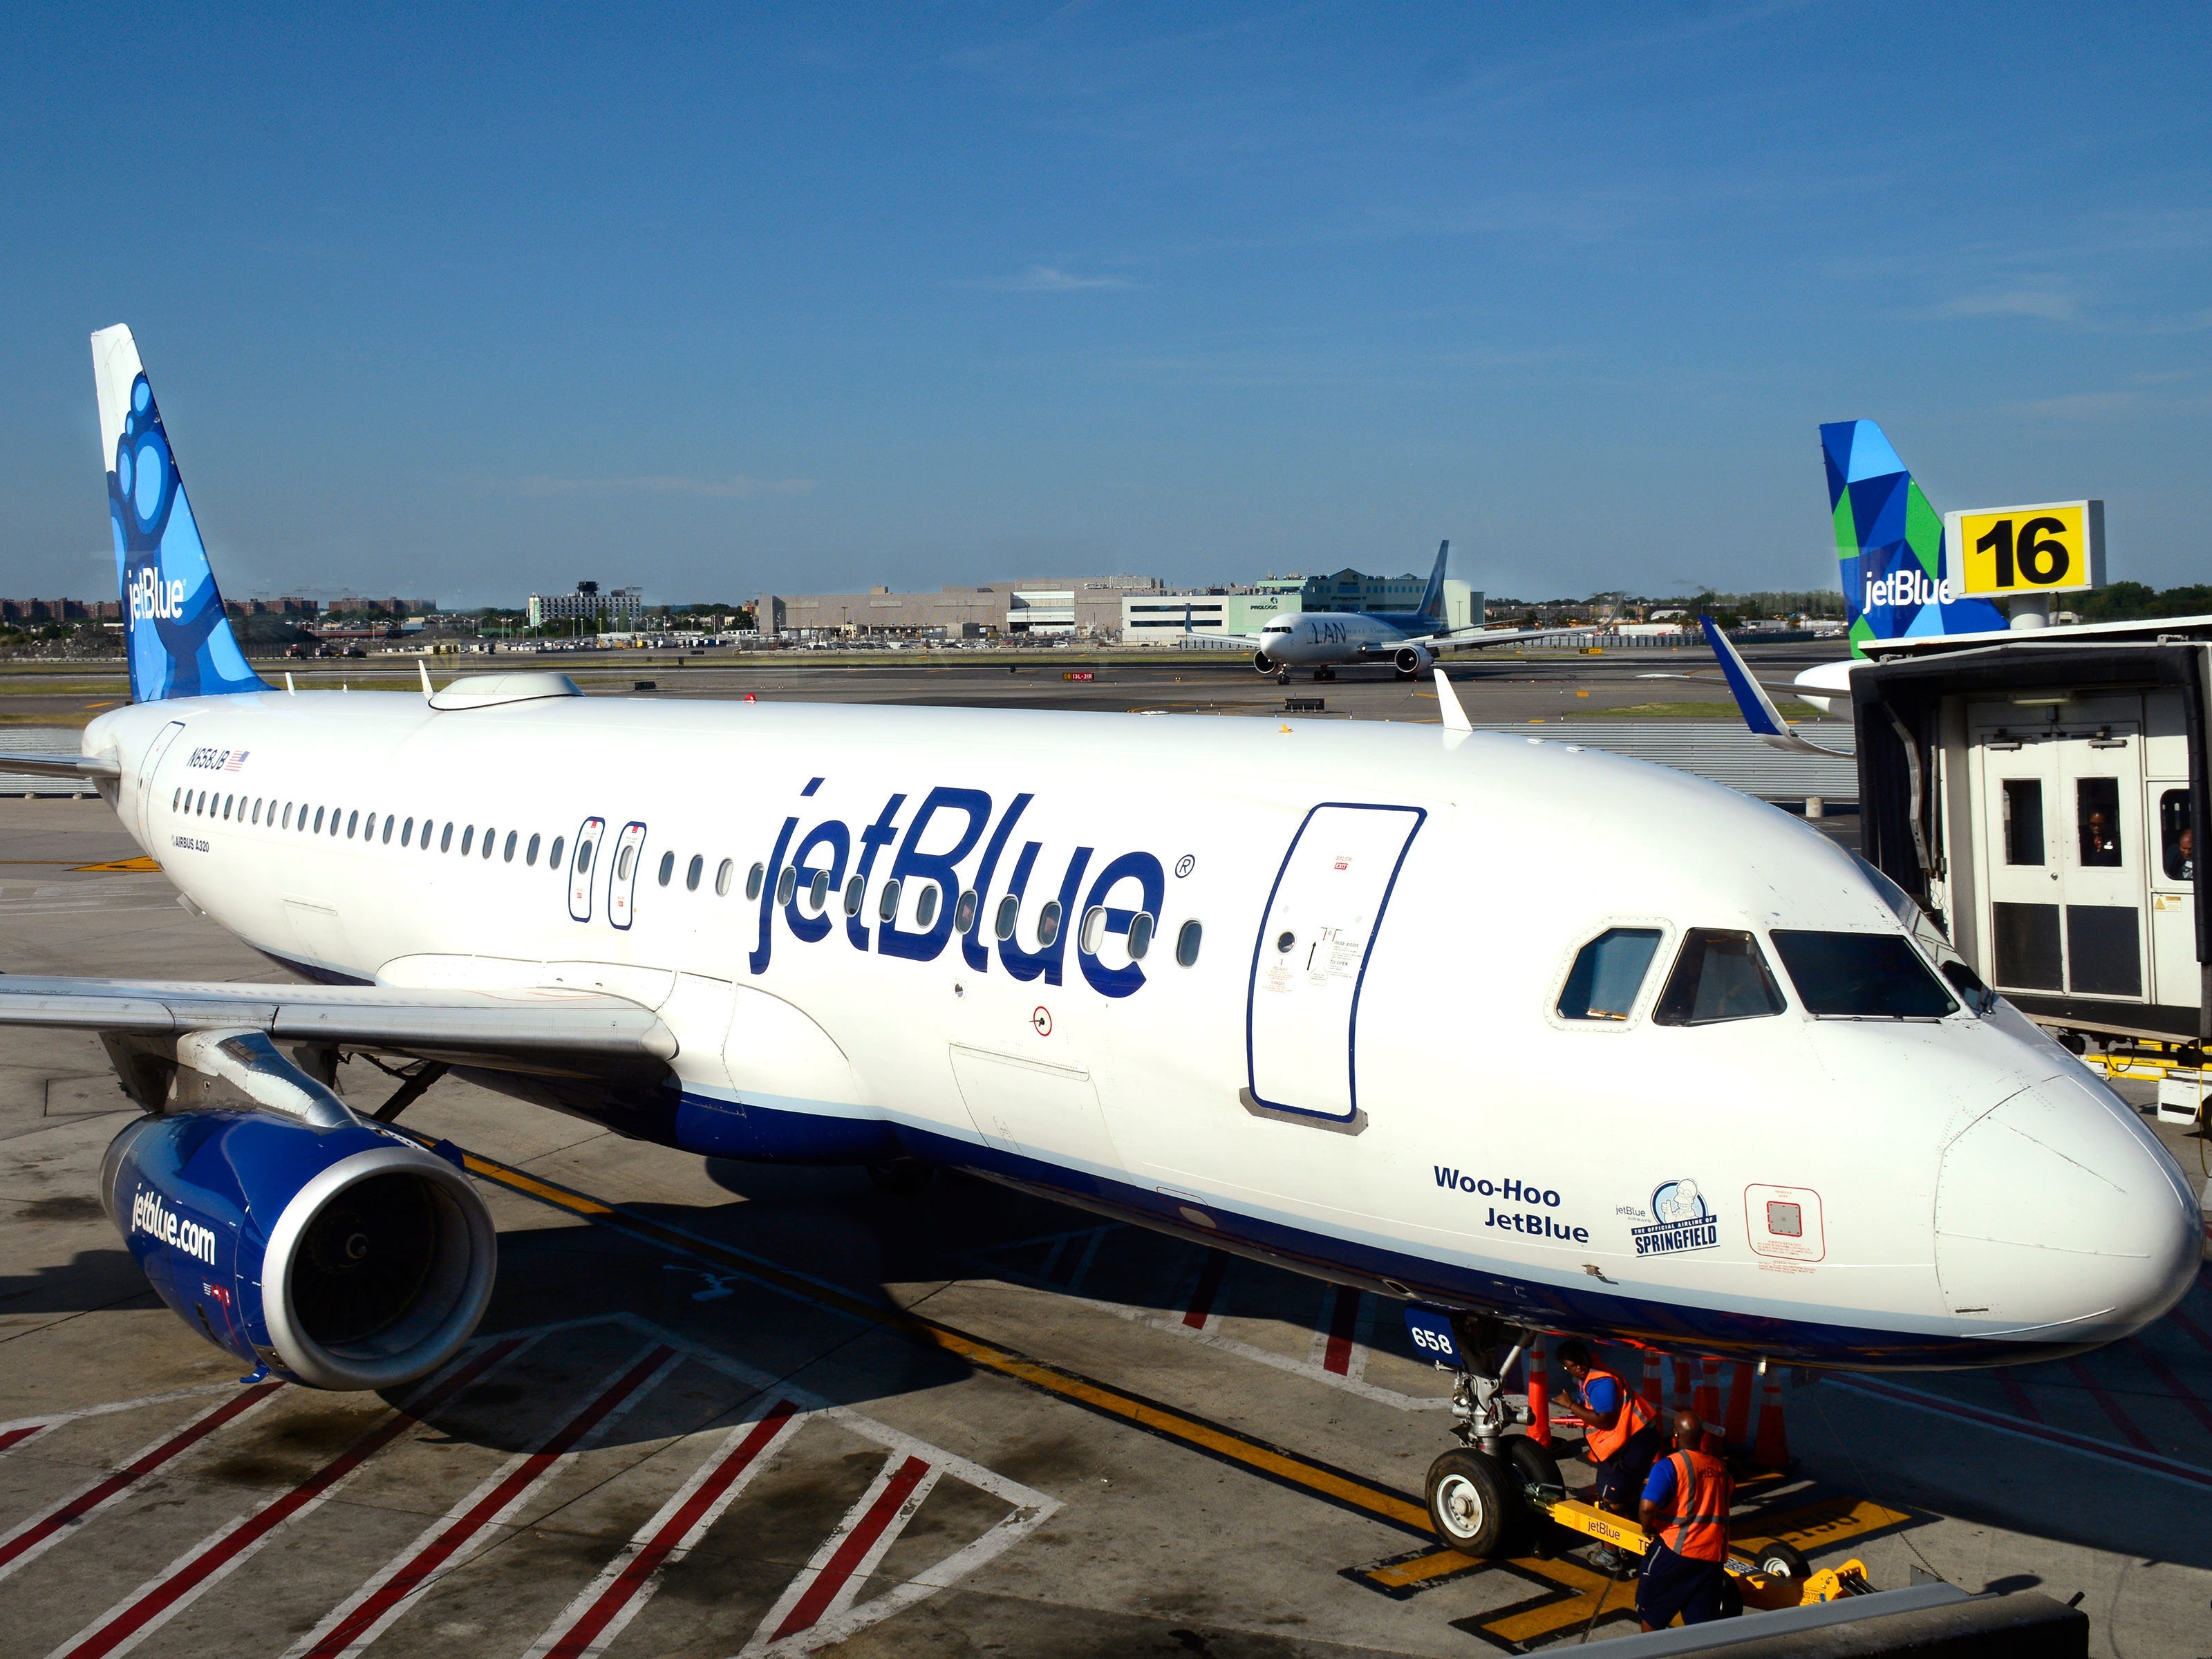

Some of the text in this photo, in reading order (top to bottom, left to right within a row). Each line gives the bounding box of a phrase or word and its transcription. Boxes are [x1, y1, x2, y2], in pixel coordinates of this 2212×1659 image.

[1976, 516, 2070, 588] 16
[129, 567, 183, 632] jetBlue
[1312, 622, 1347, 644] LAN
[186, 747, 230, 770] N658JB
[176, 835, 209, 852] AIRBUS A320
[749, 777, 1165, 998] jetBlue
[1434, 1165, 1561, 1208] Woo-Hoo
[131, 1183, 216, 1265] jetblue.com
[1485, 1208, 1589, 1244] JetBlue
[1615, 1205, 1646, 1217] jetBlue
[1647, 1224, 1675, 1232] OFFICIAL
[1678, 1219, 1703, 1228] AIRLINE
[1635, 1225, 1717, 1255] SPRINGFIELD
[1410, 1325, 1453, 1355] 658
[1588, 1518, 1620, 1540] jetBlue
